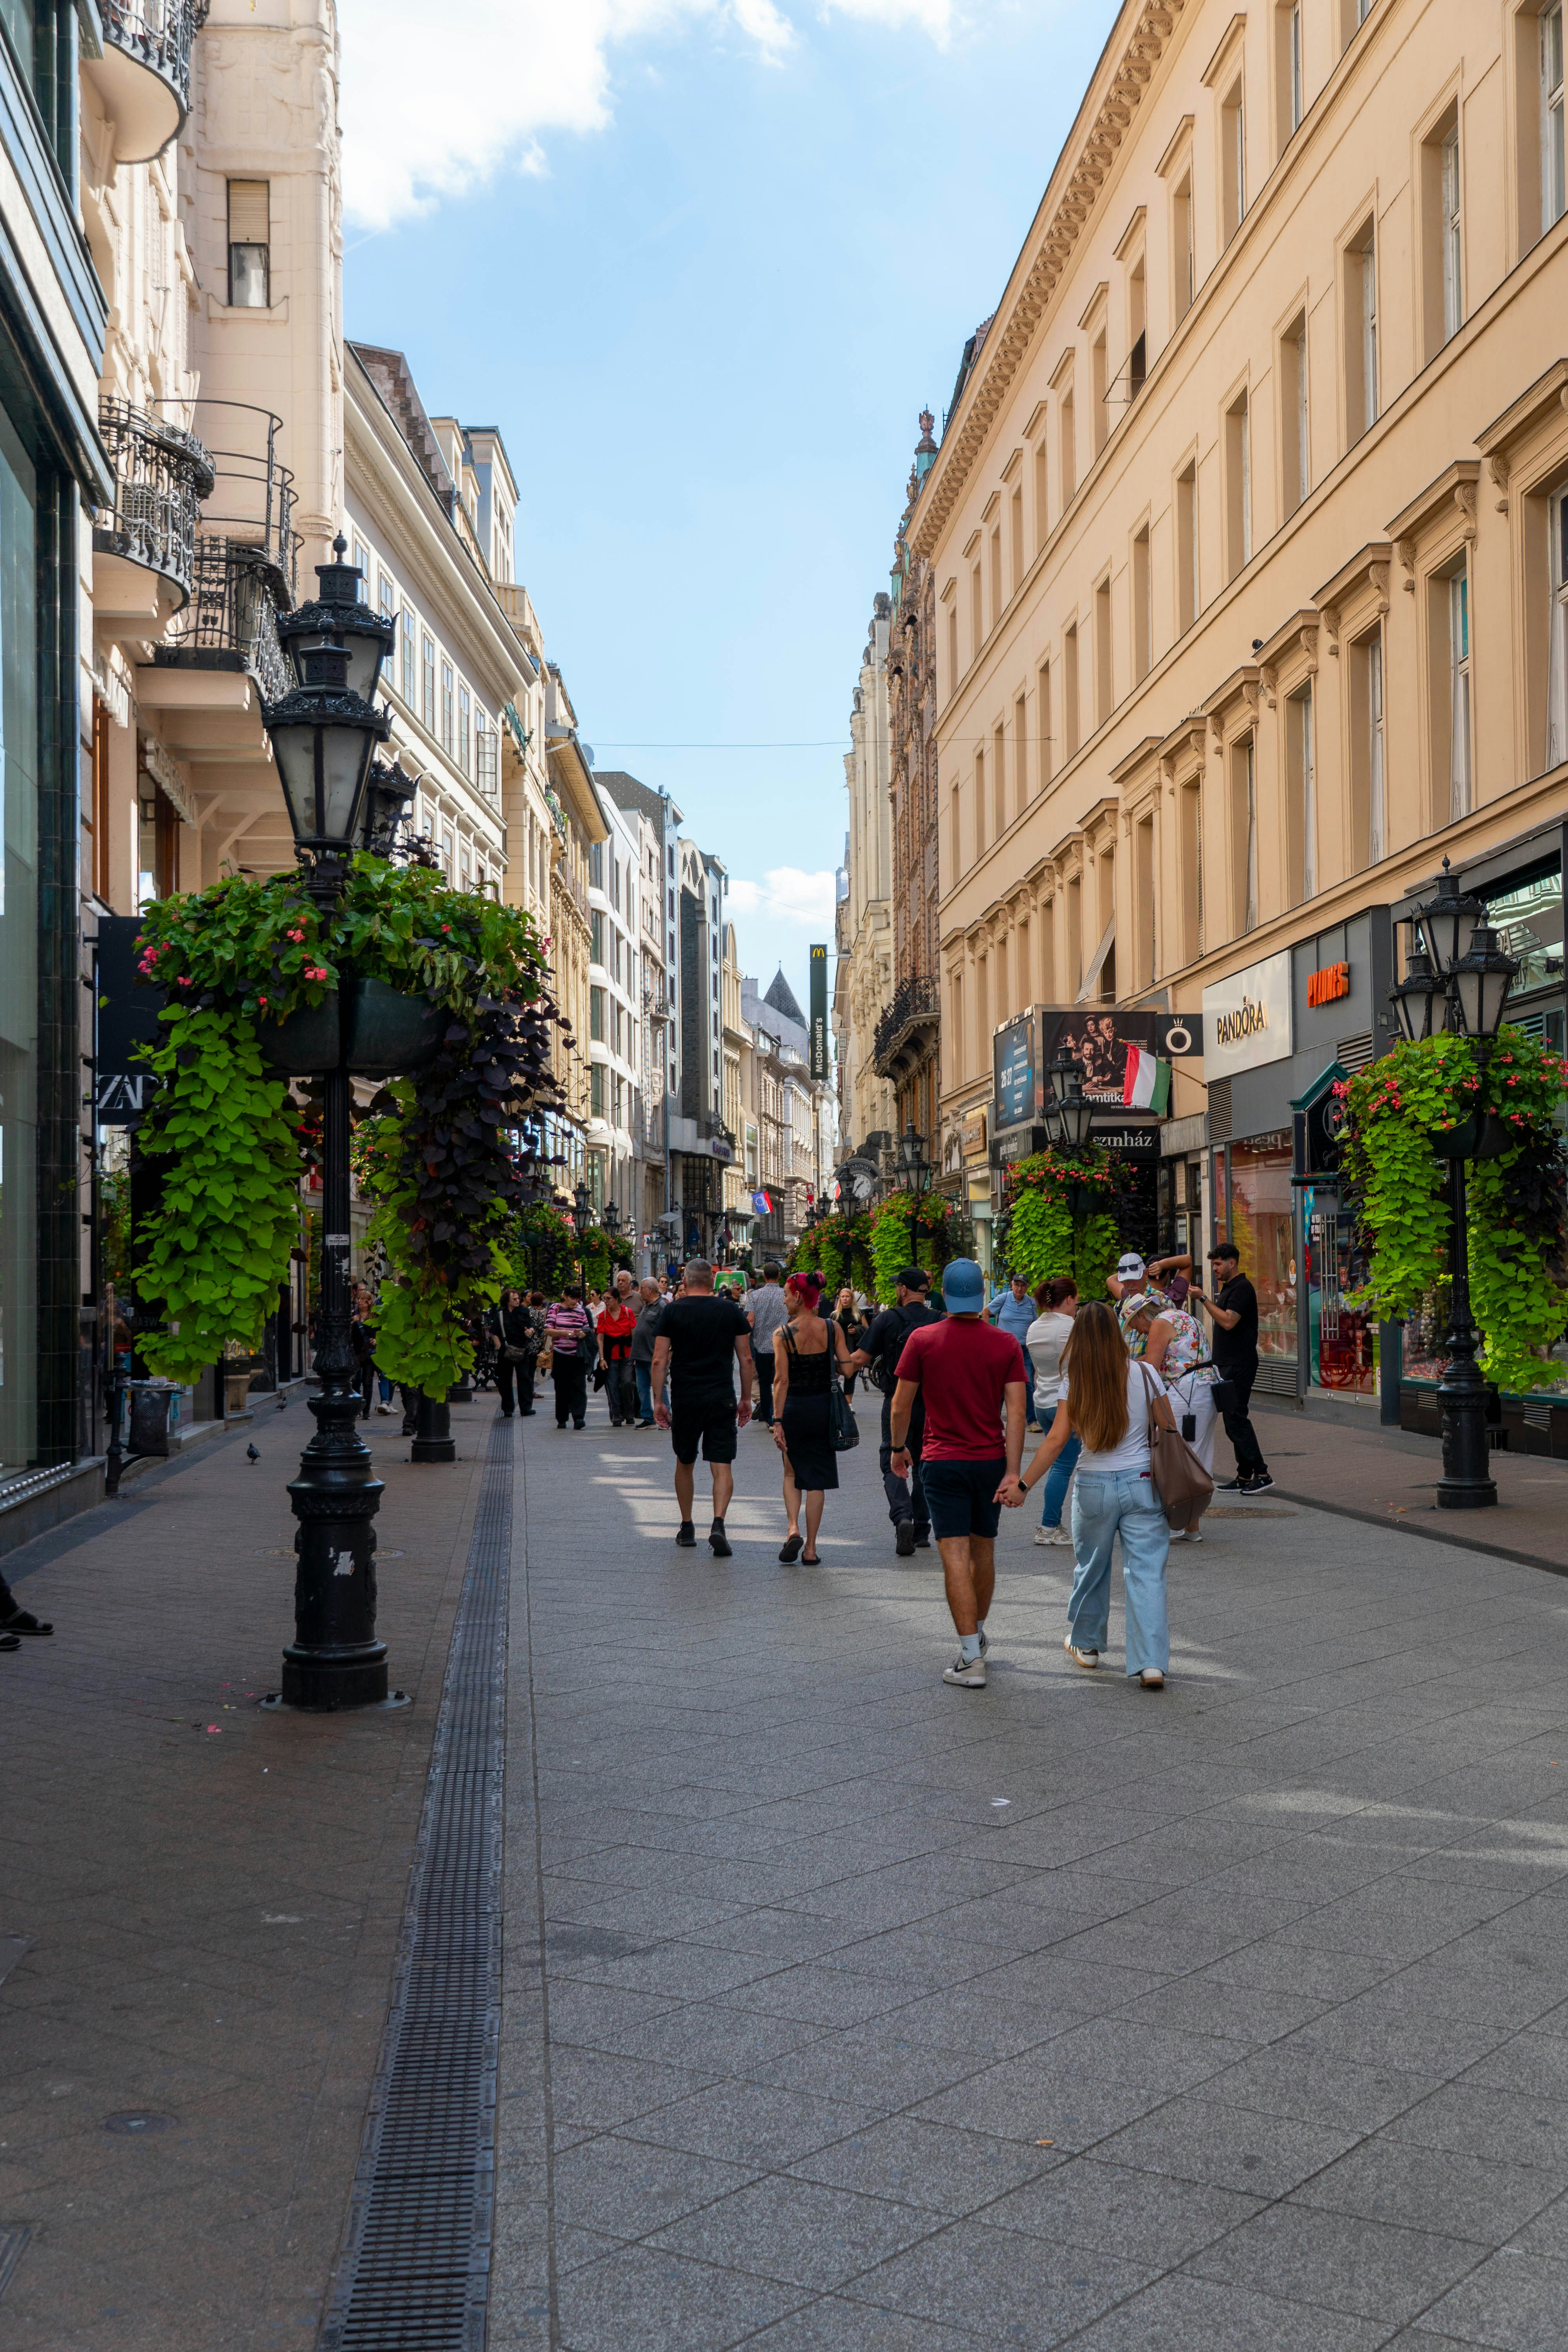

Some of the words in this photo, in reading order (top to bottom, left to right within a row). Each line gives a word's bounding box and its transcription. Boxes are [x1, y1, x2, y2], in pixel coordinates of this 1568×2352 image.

[1307, 961, 1348, 1008] PYLONES
[1217, 1000, 1265, 1044] PANDORA
[98, 1074, 168, 1109] ZAR
[1001, 1069, 1007, 1089] 26
[1007, 1067, 1012, 1086] 27
